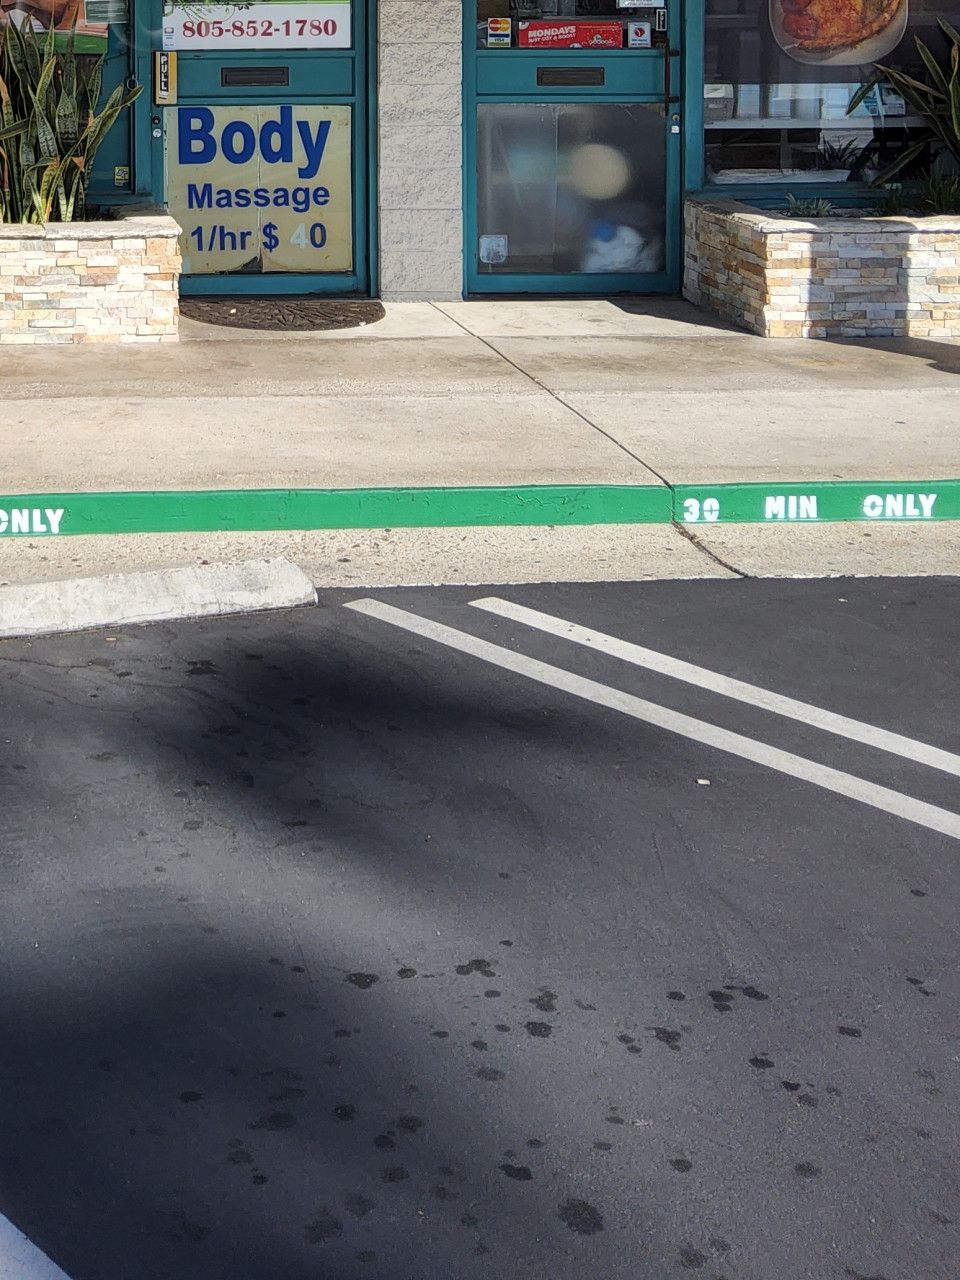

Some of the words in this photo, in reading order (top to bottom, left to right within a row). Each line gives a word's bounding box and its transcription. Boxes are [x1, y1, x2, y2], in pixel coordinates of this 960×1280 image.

[182, 19, 338, 38] 805-852-1780
[528, 25, 577, 39] MONDAYS
[160, 55, 169, 90] PULL
[177, 104, 332, 180] Body
[187, 183, 330, 213] Massage
[191, 224, 252, 252] 1/hr
[683, 497, 720, 522] 30
[764, 495, 818, 519] MIN
[862, 493, 938, 517] ONLY
